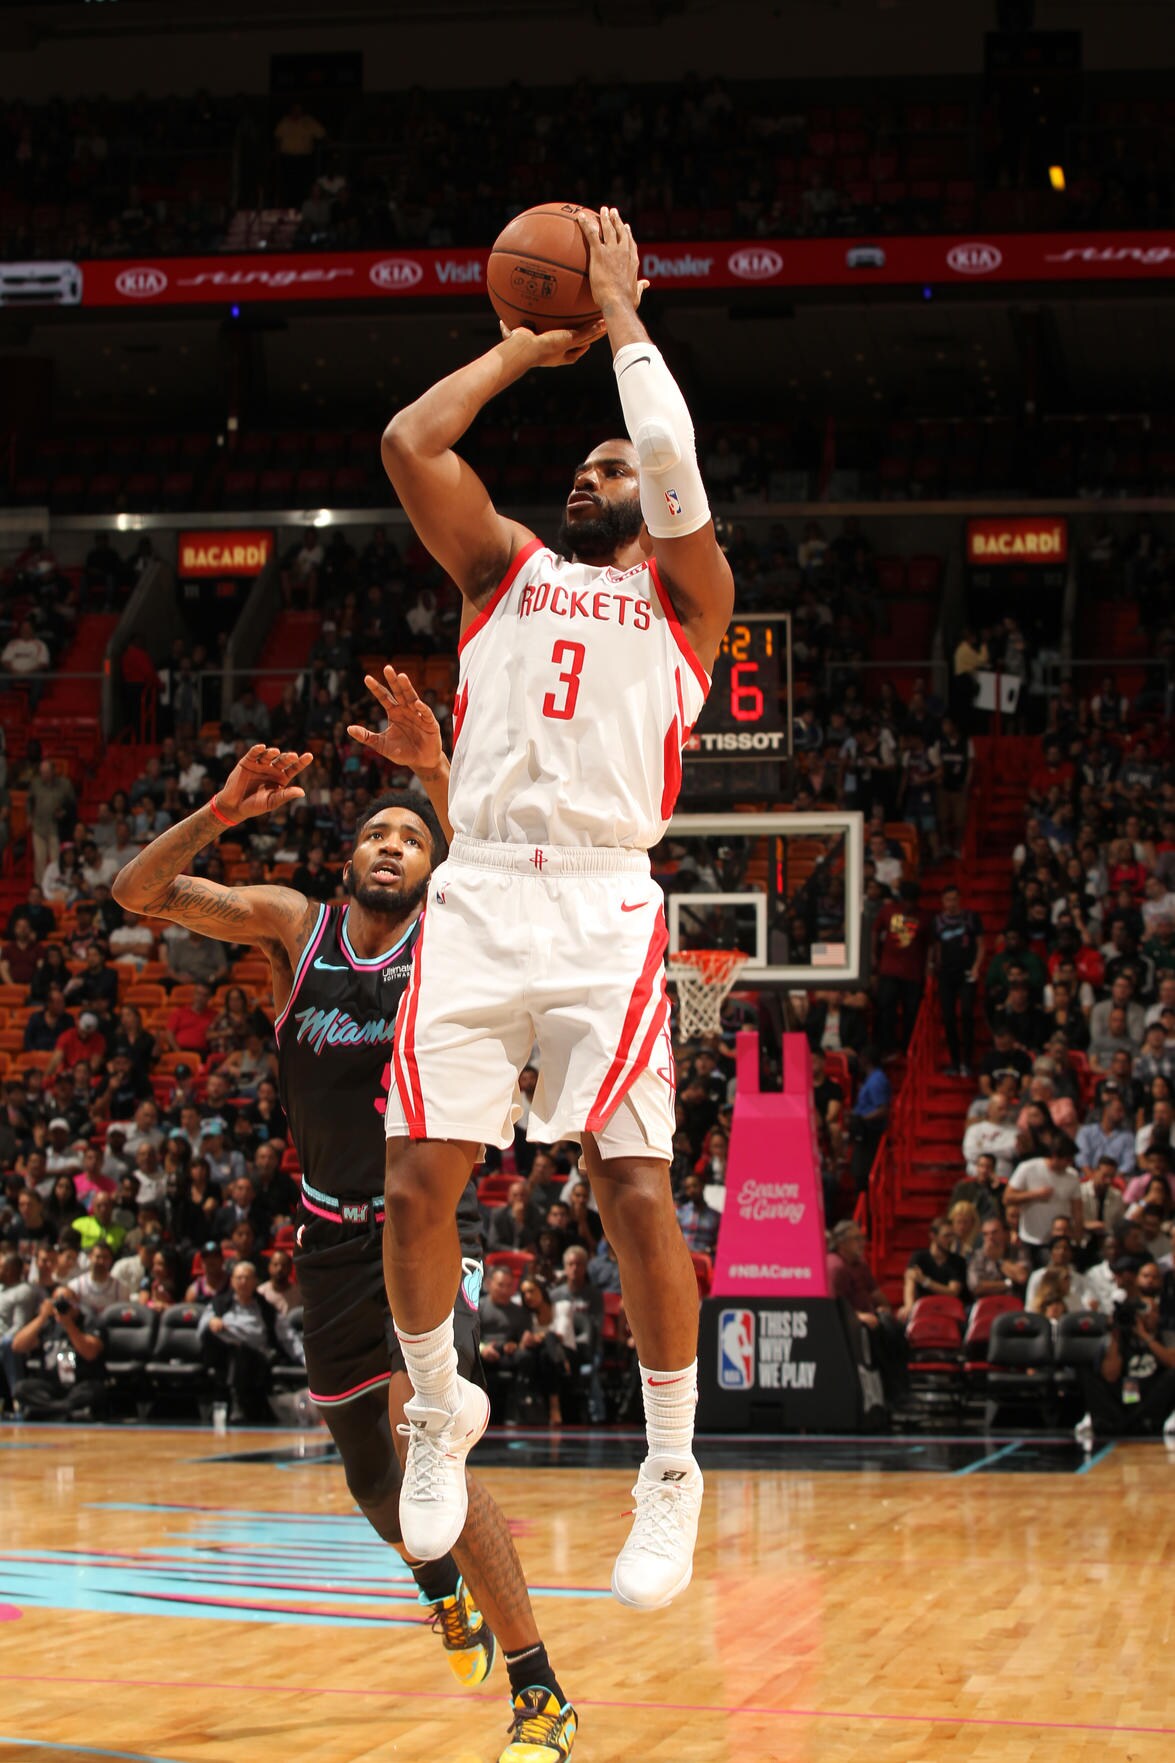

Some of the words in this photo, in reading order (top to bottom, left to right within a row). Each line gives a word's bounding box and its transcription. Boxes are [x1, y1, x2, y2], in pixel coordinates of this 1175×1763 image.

[434, 260, 481, 284] Visit
[642, 253, 714, 278] Dealer
[519, 582, 651, 631] ROCKETS
[715, 625, 774, 661] :21
[541, 638, 587, 721] 3
[730, 661, 764, 722] 6
[700, 731, 785, 751] TISSOT
[736, 1179, 799, 1206] Season
[752, 1199, 806, 1224] Giving
[728, 1263, 812, 1280] #NBACares
[758, 1310, 792, 1337] THIS
[792, 1310, 808, 1338] IS
[758, 1337, 793, 1362] WHY
[758, 1362, 781, 1388] WE
[781, 1362, 817, 1389] PLAY
